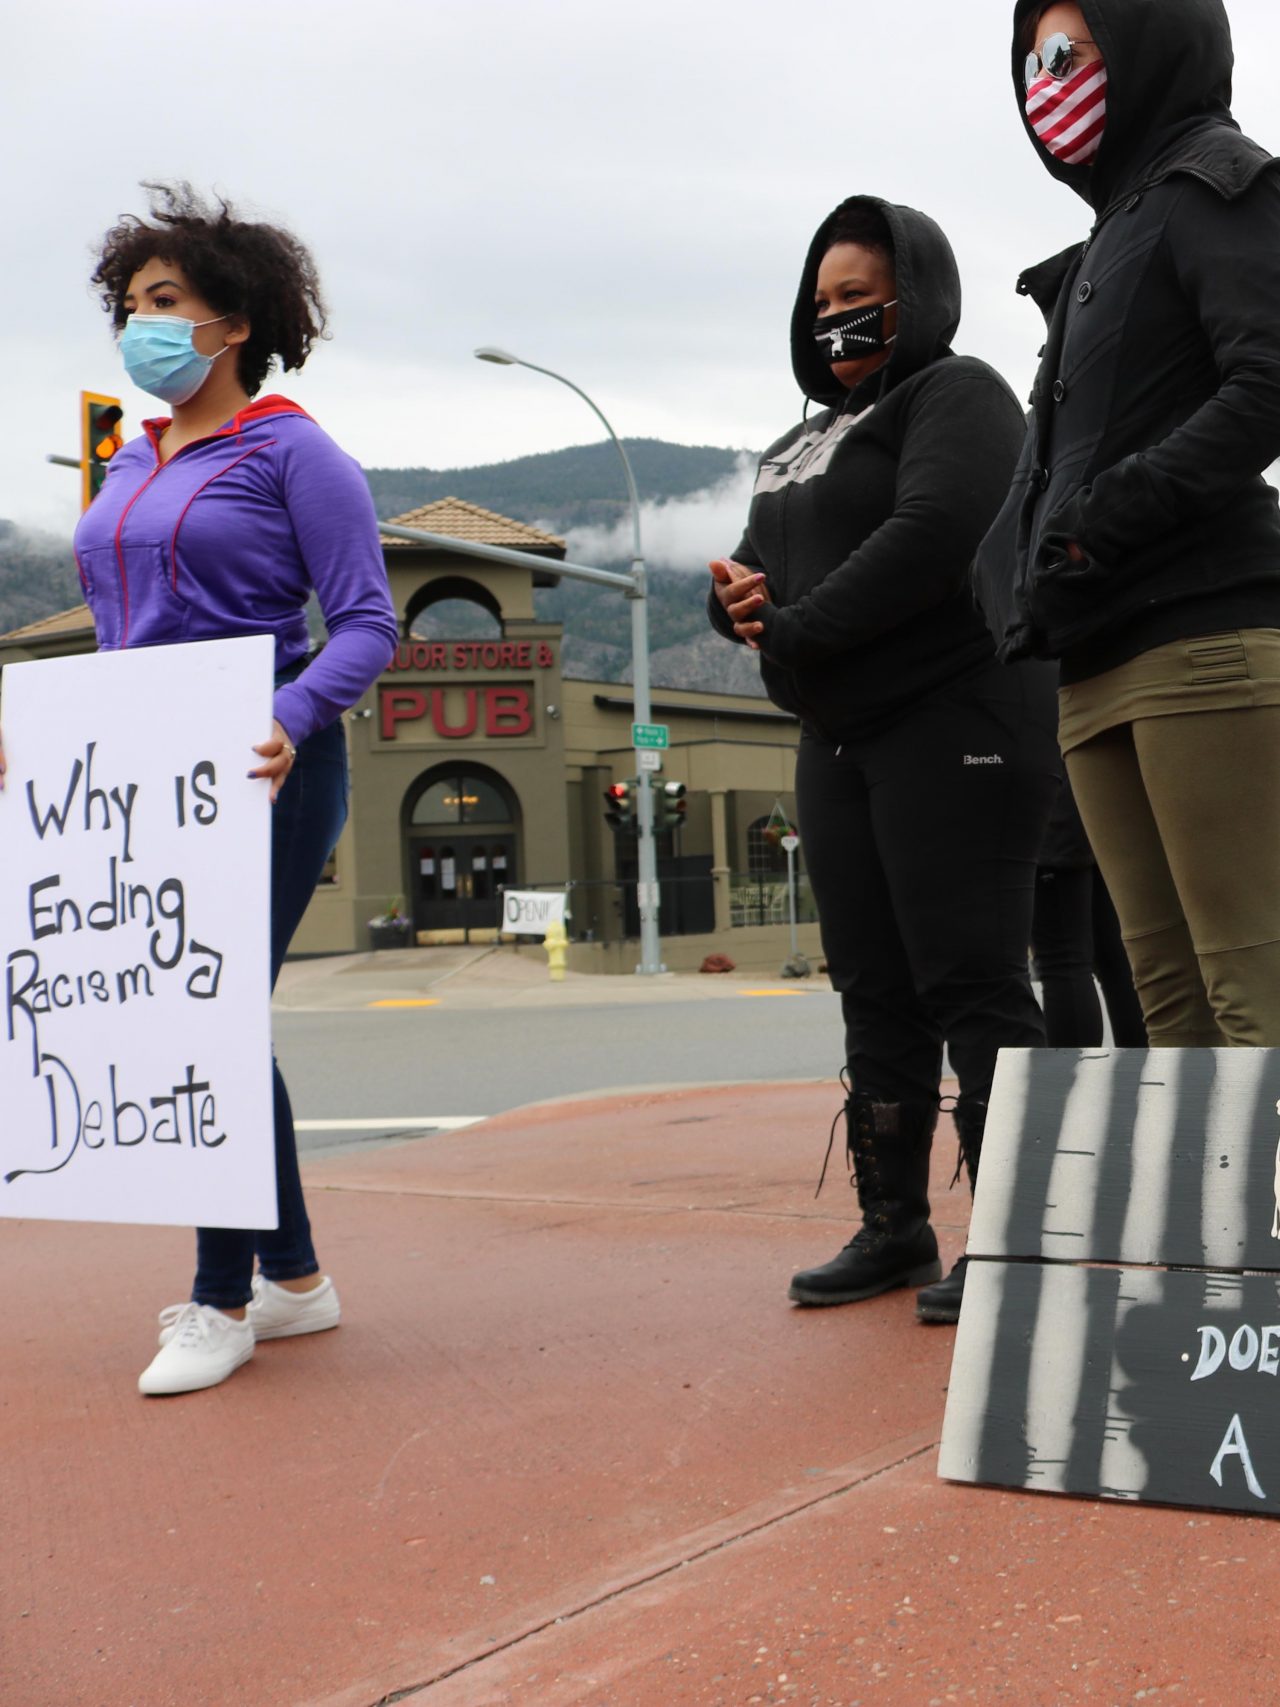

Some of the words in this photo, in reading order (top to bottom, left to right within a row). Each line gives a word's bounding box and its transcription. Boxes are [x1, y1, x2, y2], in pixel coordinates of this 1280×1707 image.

[453, 642, 532, 669] STORE
[537, 641, 553, 668] &
[381, 688, 533, 739] PUB
[26, 742, 138, 862] Why
[28, 857, 185, 969] Ending
[6, 949, 154, 1077] Racism
[186, 939, 223, 999] a
[4, 1053, 227, 1183] Debate
[1209, 1413, 1266, 1499] A
